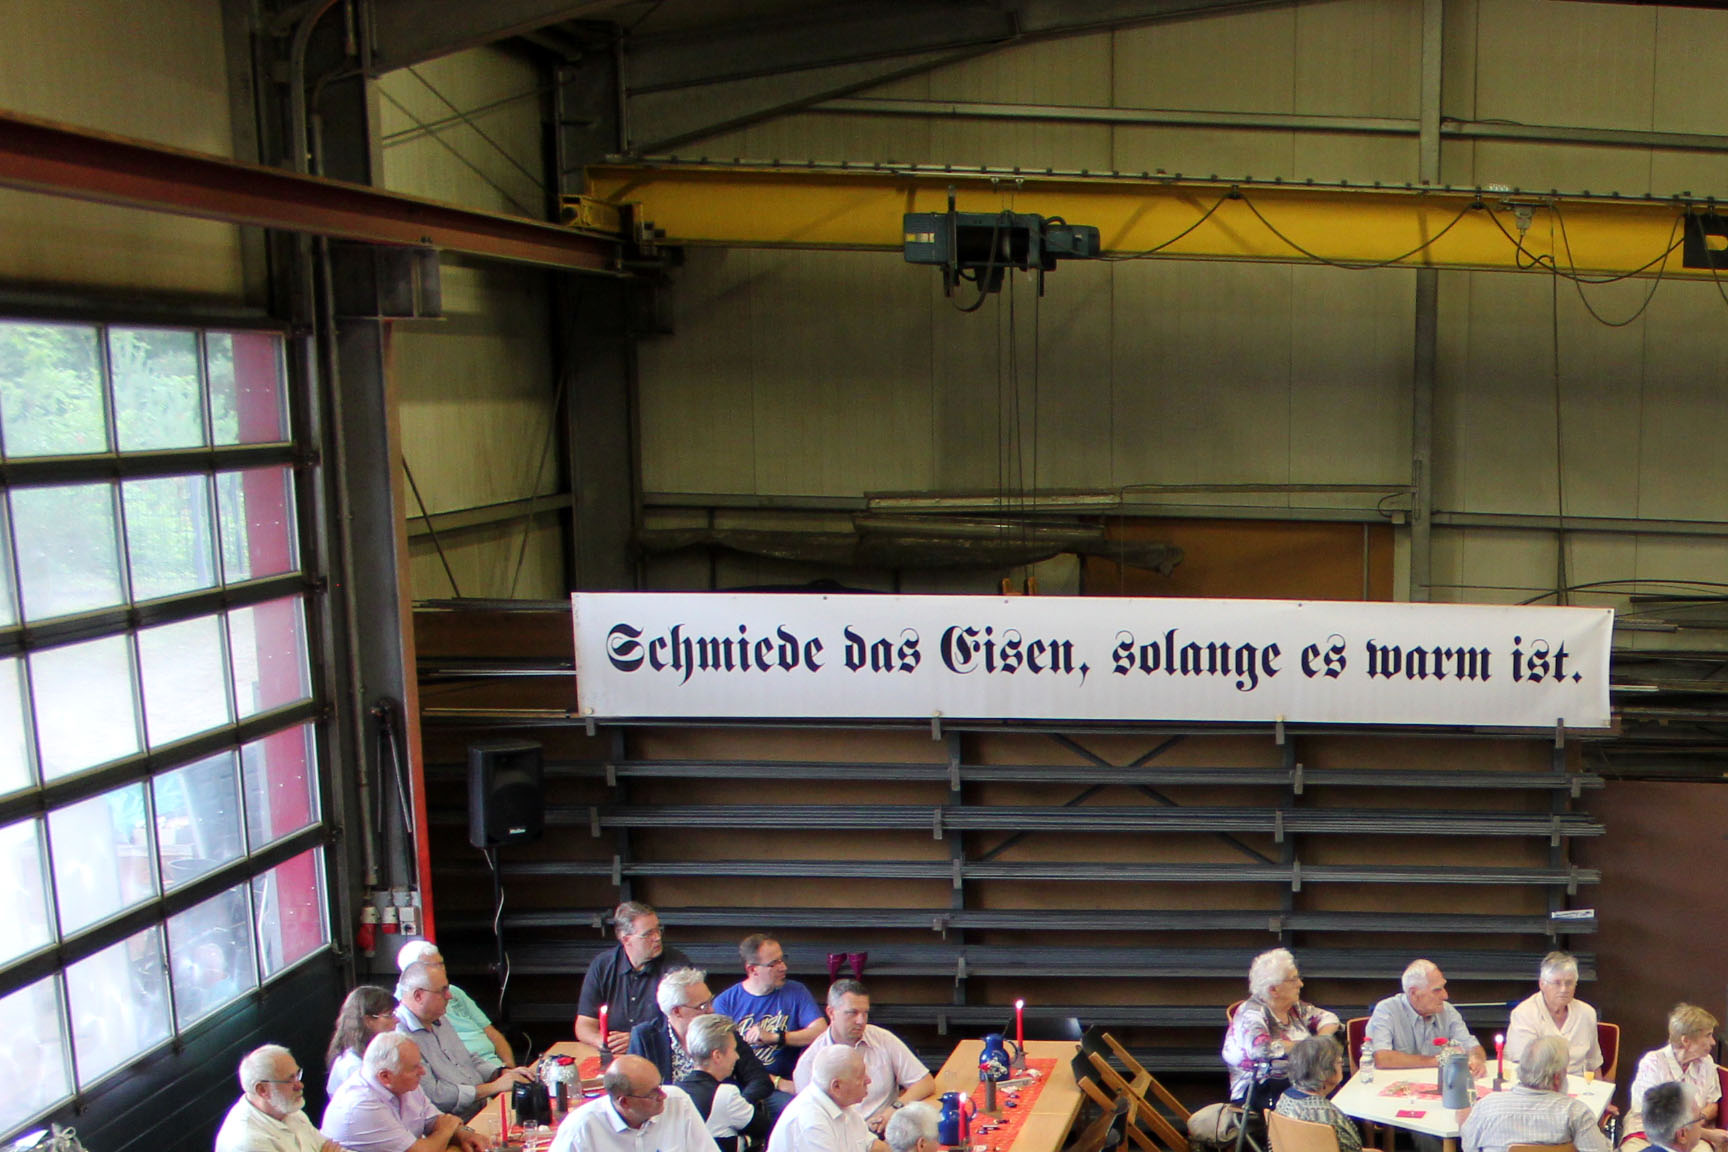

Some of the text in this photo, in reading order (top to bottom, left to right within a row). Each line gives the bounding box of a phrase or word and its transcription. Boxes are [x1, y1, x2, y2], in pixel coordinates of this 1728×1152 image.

[606, 622, 1583, 692] Schmiede das Eisen, solange es warm ist.
